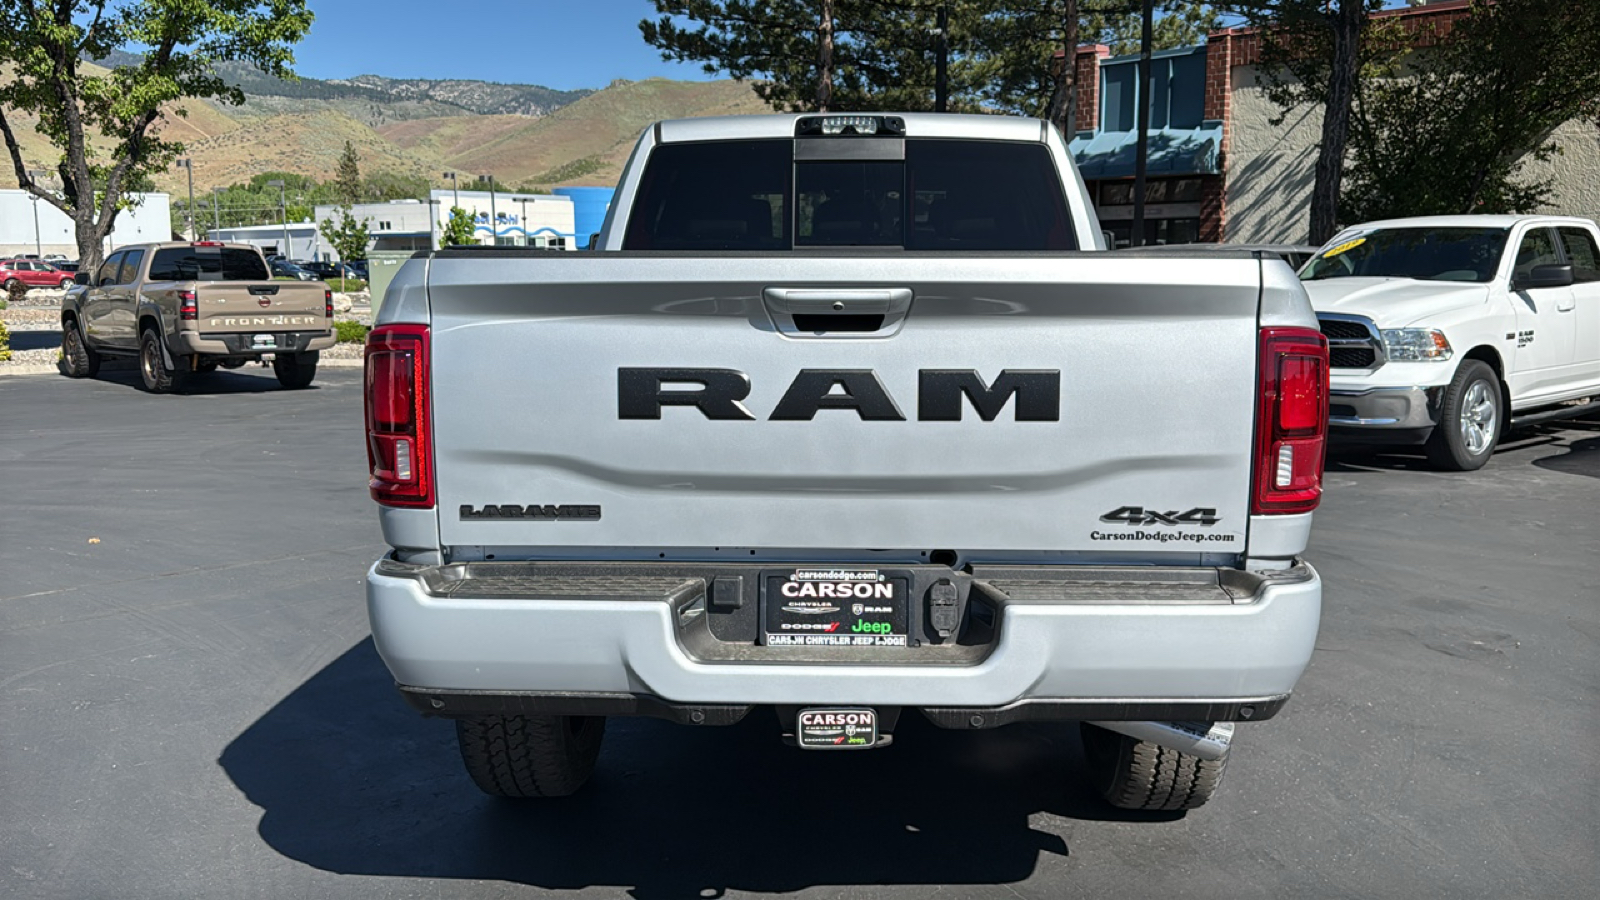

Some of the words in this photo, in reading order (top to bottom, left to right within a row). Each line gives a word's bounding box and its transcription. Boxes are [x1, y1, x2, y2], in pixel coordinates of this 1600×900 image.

[210, 316, 315, 327] FRONTIER
[618, 367, 1061, 422] RAM
[459, 504, 602, 522] LARAMIE
[1090, 530, 1235, 544] CarsonDodgeJeep.com
[798, 570, 877, 580] carsondodge.com
[781, 582, 894, 599] CARSON
[864, 605, 893, 613] RAM
[851, 618, 892, 635] Jeep
[805, 634, 851, 646] CHRYSLER
[852, 634, 874, 646] JEEP
[802, 713, 872, 725] CARSON
